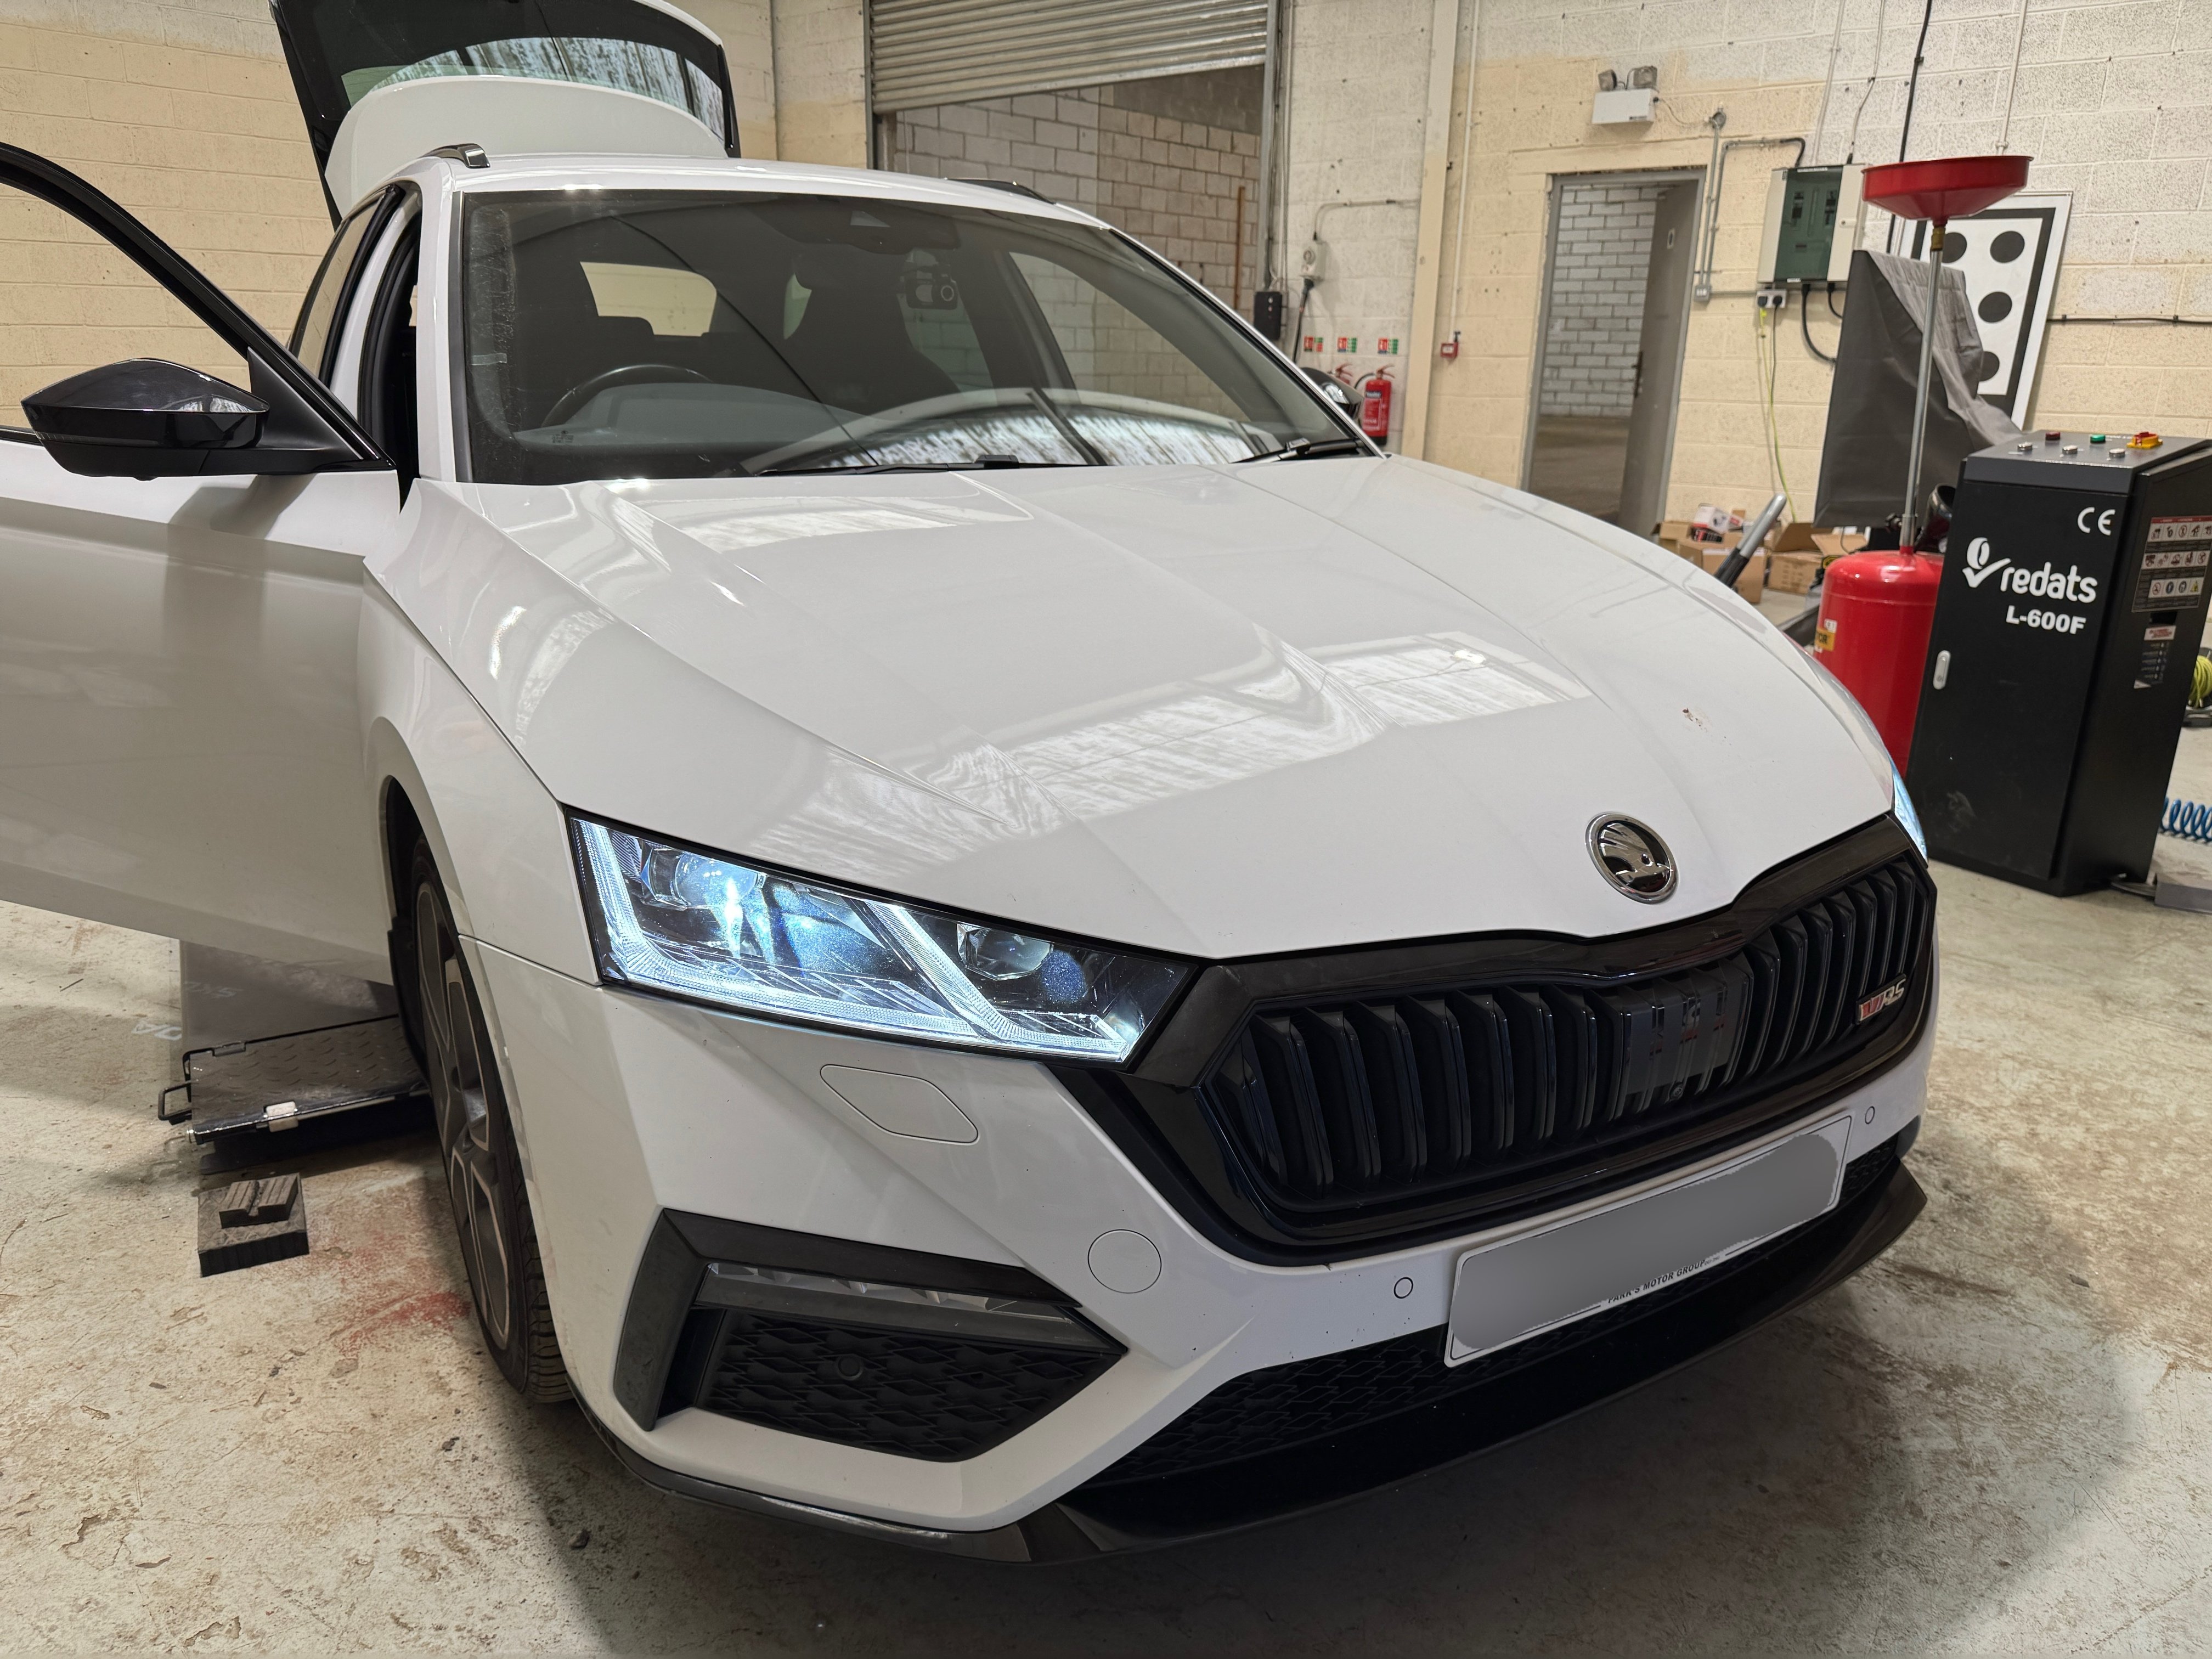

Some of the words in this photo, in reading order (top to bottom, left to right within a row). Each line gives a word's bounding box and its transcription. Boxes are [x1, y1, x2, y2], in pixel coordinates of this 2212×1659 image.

[2077, 507, 2115, 535] CE
[2000, 562, 2098, 603] redats
[2006, 605, 2086, 634] L-600F
[1643, 1271, 1674, 1290] MOTOR
[1677, 1259, 1706, 1277] GROUP
